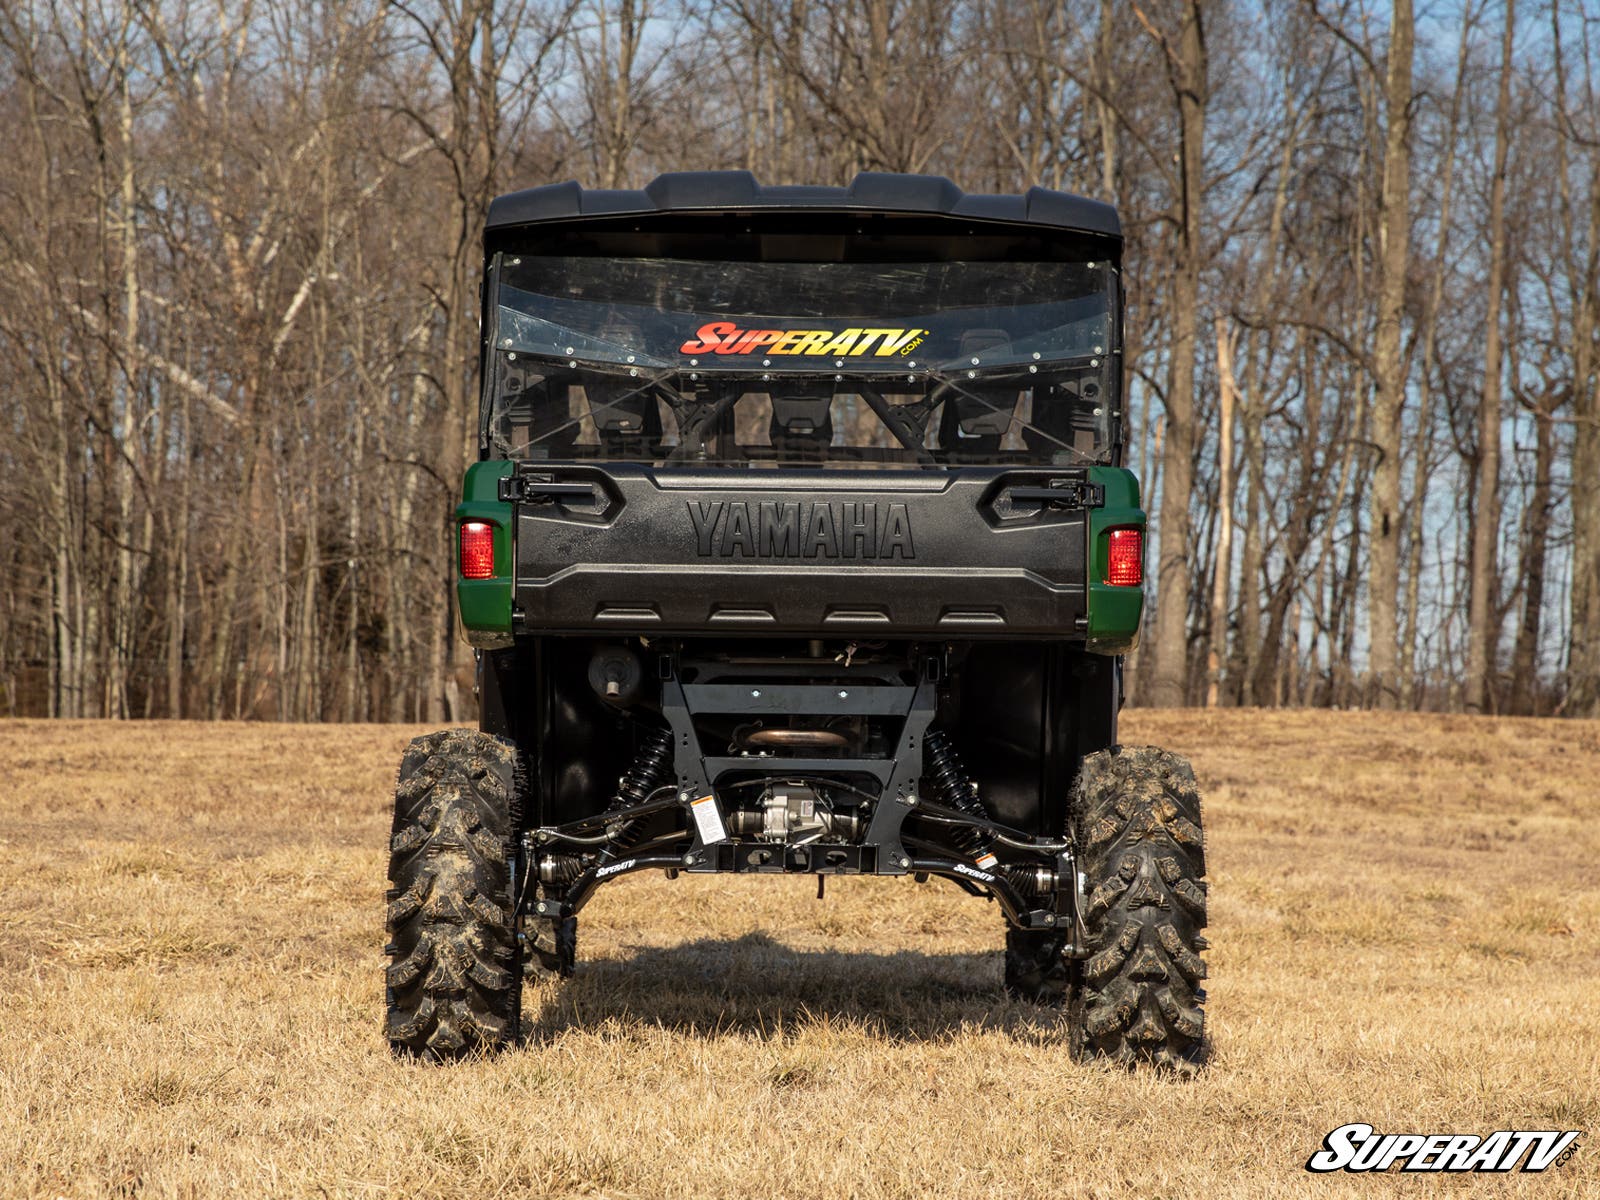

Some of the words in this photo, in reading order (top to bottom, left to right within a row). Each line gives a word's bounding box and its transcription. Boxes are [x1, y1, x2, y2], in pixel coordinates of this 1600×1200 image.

[679, 321, 924, 357] SUPERATV
[686, 501, 916, 559] YAMAHA
[595, 858, 637, 878] SUPERATV
[953, 863, 996, 882] SUPERATV
